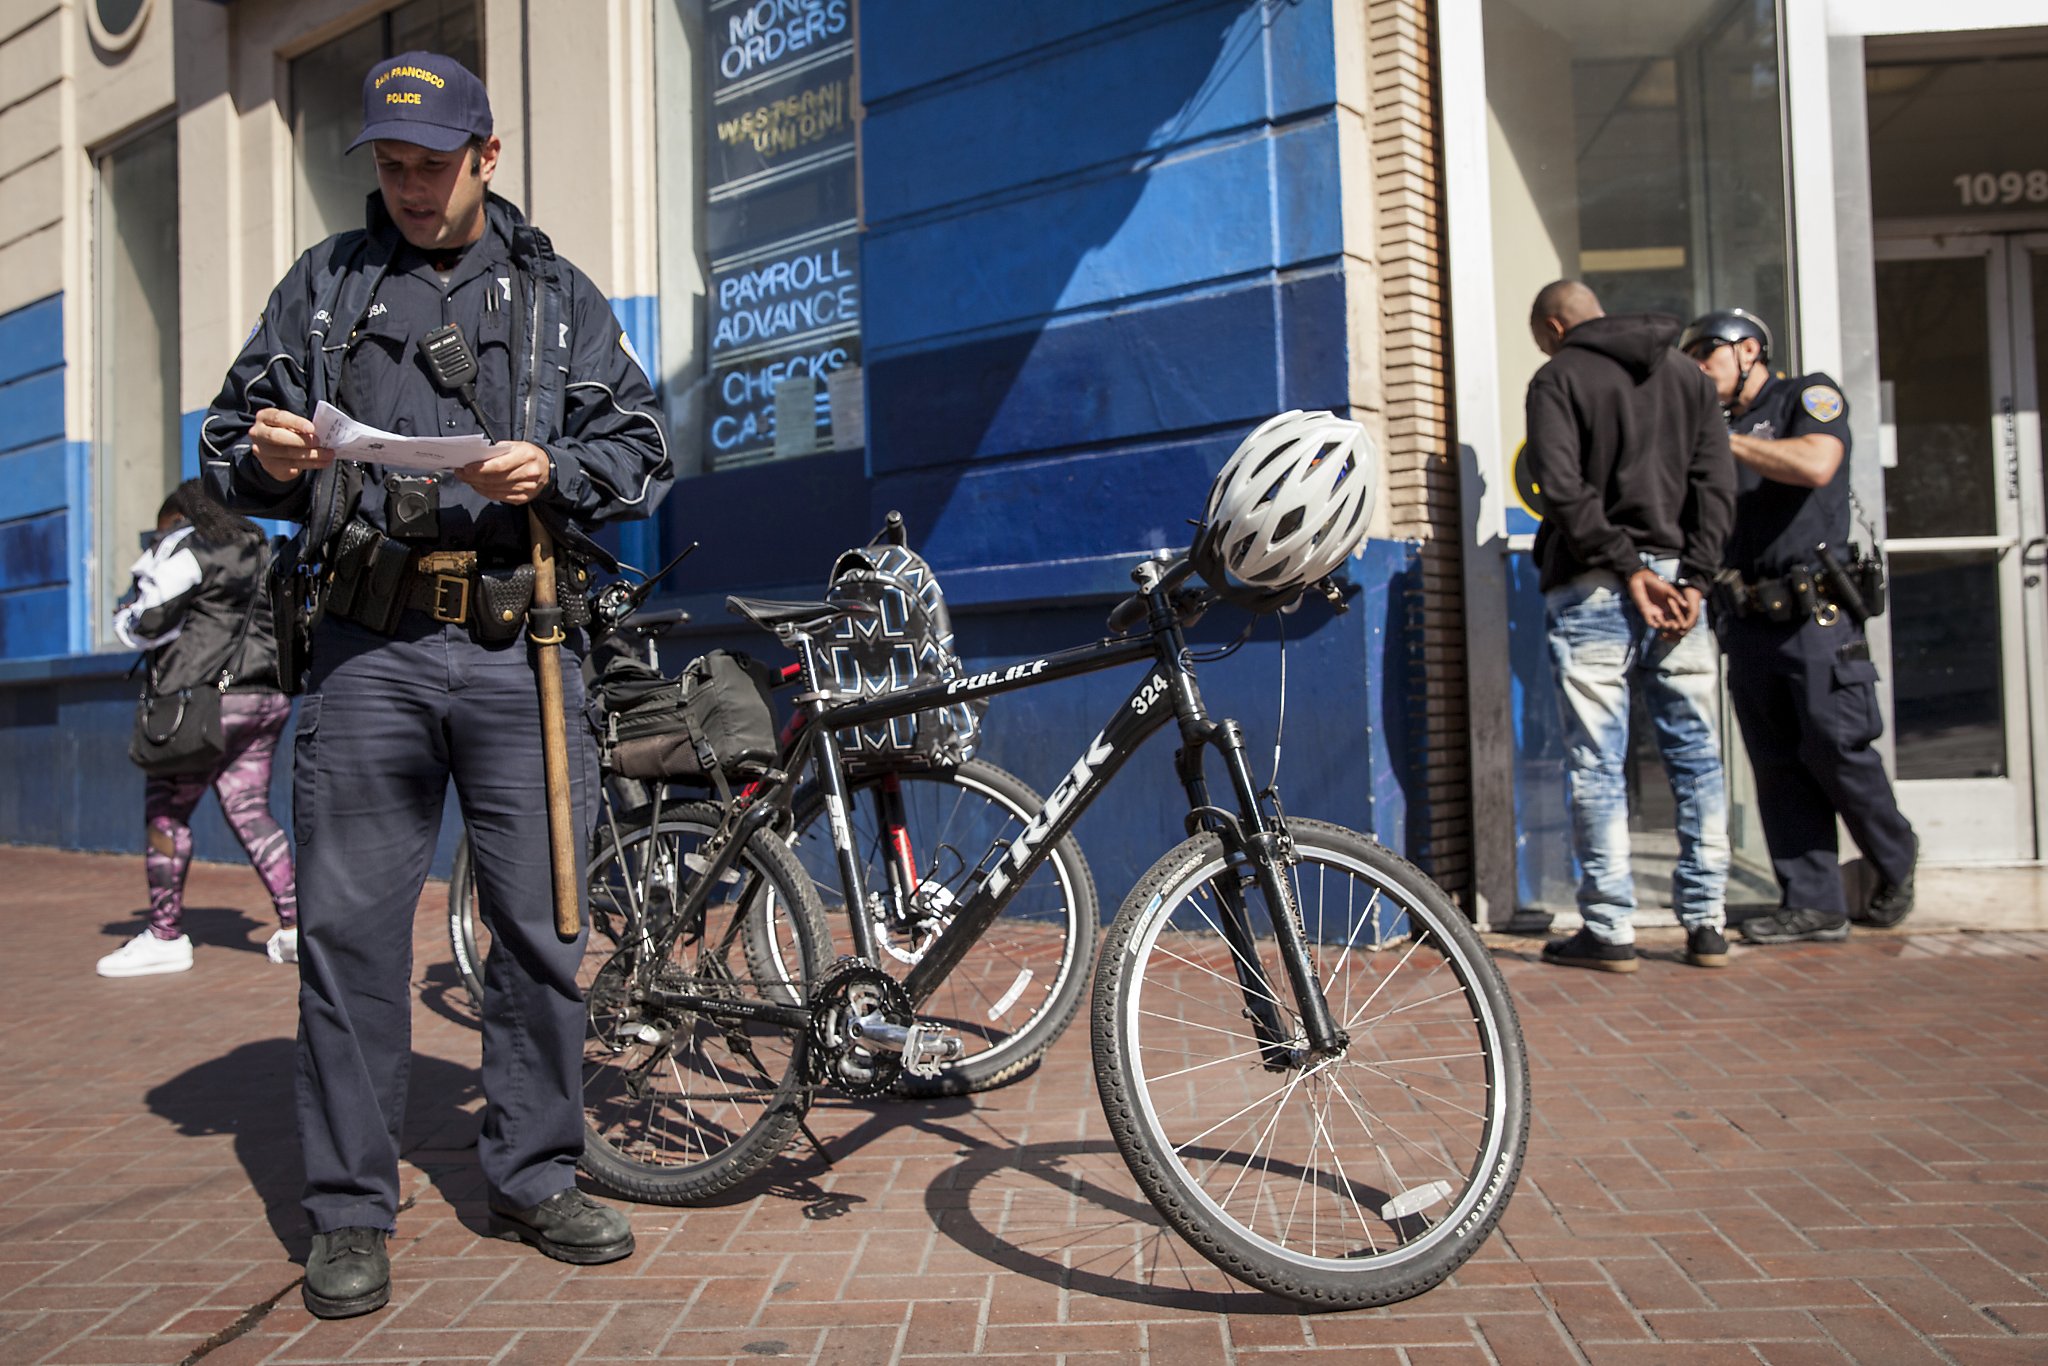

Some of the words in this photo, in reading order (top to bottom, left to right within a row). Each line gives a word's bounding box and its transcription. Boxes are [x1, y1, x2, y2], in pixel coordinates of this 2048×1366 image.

[721, 0, 847, 79] ORDERS
[375, 73, 390, 89] SAN
[391, 65, 445, 89] FRANCISCO
[386, 92, 422, 105] POLICE
[717, 81, 836, 142] WESTERN
[753, 108, 835, 152] UNION
[1953, 169, 2048, 206] 1098
[720, 248, 853, 311] PAYROLL
[713, 284, 859, 348] ADVANCE
[946, 659, 1048, 694] POLICE
[1131, 673, 1169, 715] 324
[978, 728, 1114, 899] TREK
[1455, 1151, 1510, 1238] BONTRAGER
